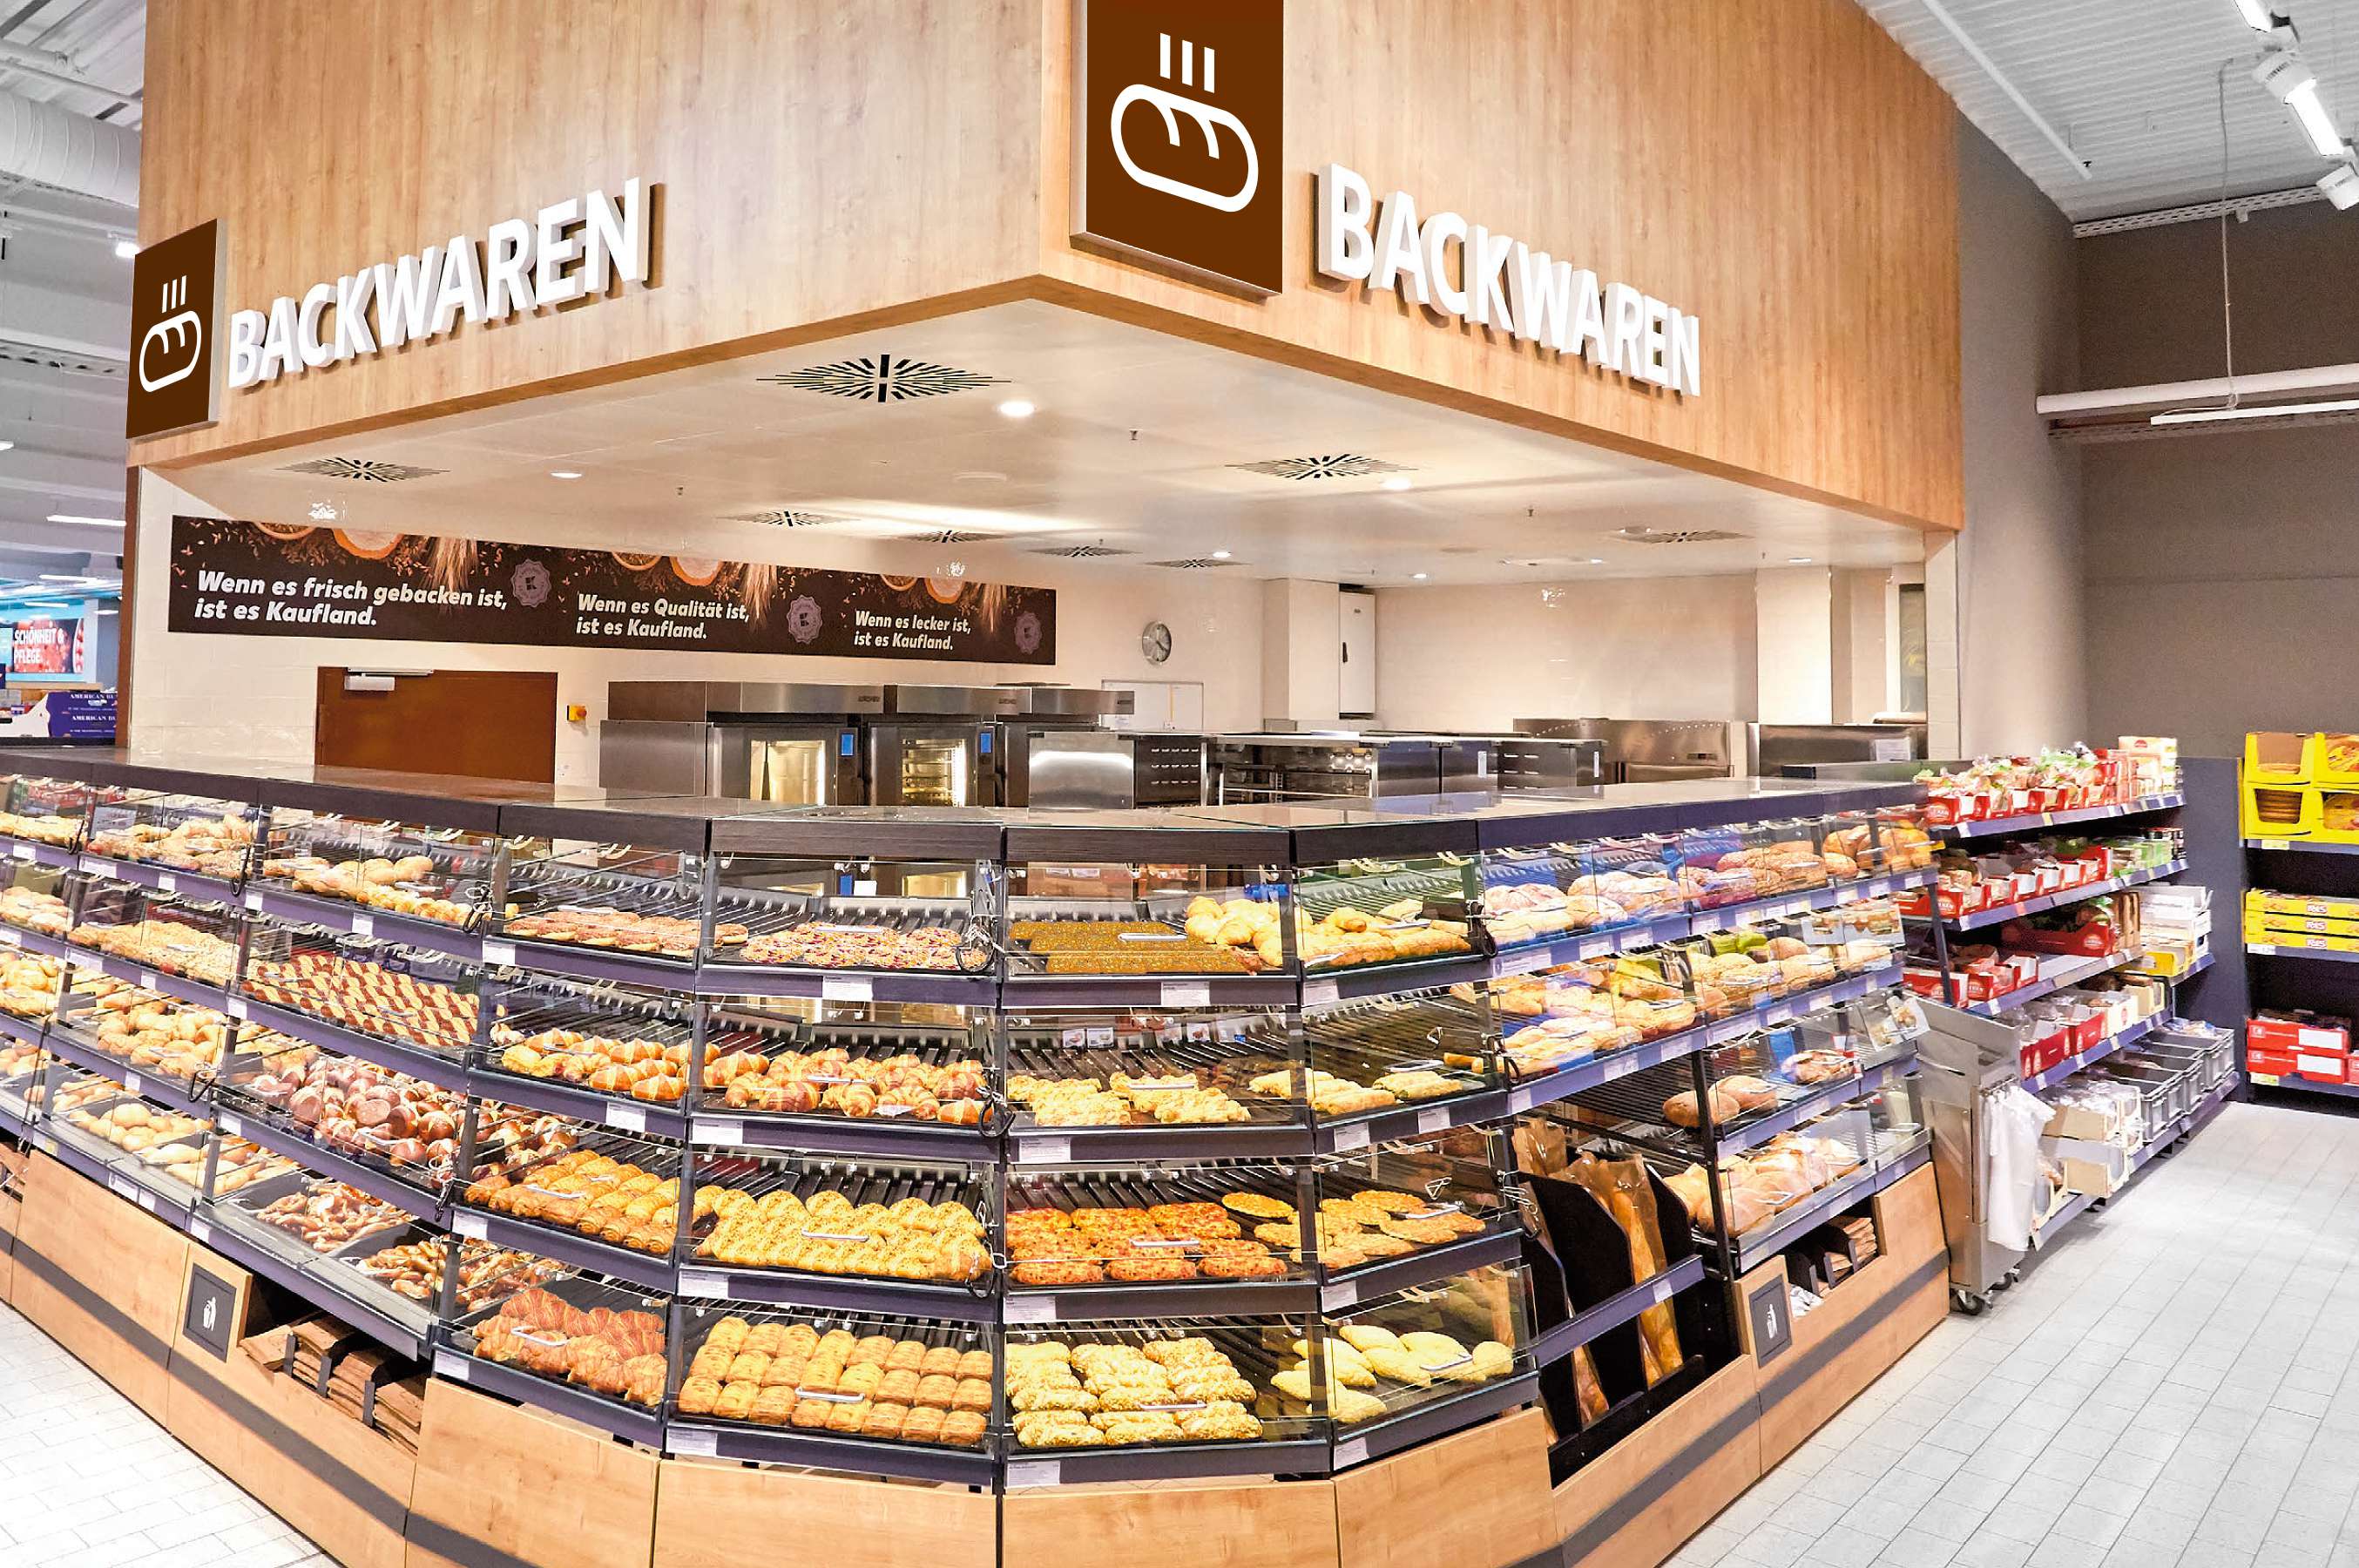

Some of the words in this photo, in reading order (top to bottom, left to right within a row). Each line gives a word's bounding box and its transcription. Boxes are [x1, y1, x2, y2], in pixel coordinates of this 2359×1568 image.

[228, 177, 651, 389] BACKWAREN
[1317, 163, 1700, 396] BACKWAREN
[198, 570, 266, 595] Wenn
[271, 581, 298, 596] es
[303, 578, 368, 600] frisch
[373, 583, 473, 606] gebacken
[477, 588, 507, 610] ist,
[194, 598, 228, 619] ist
[233, 605, 260, 620] es
[266, 601, 377, 625] Kaufland.
[578, 593, 627, 613] Wenn
[631, 602, 650, 614] es
[653, 598, 724, 618] Qualität
[725, 603, 750, 623] ist,
[855, 610, 892, 628] Wenn
[895, 617, 909, 629] es
[912, 614, 950, 631] lecker
[952, 618, 971, 634] ist,
[576, 616, 600, 634] ist
[604, 622, 623, 635] es
[626, 618, 707, 639] Kaufland.
[854, 630, 872, 646] ist
[875, 635, 889, 647] es
[892, 632, 953, 651] Kaufland.
